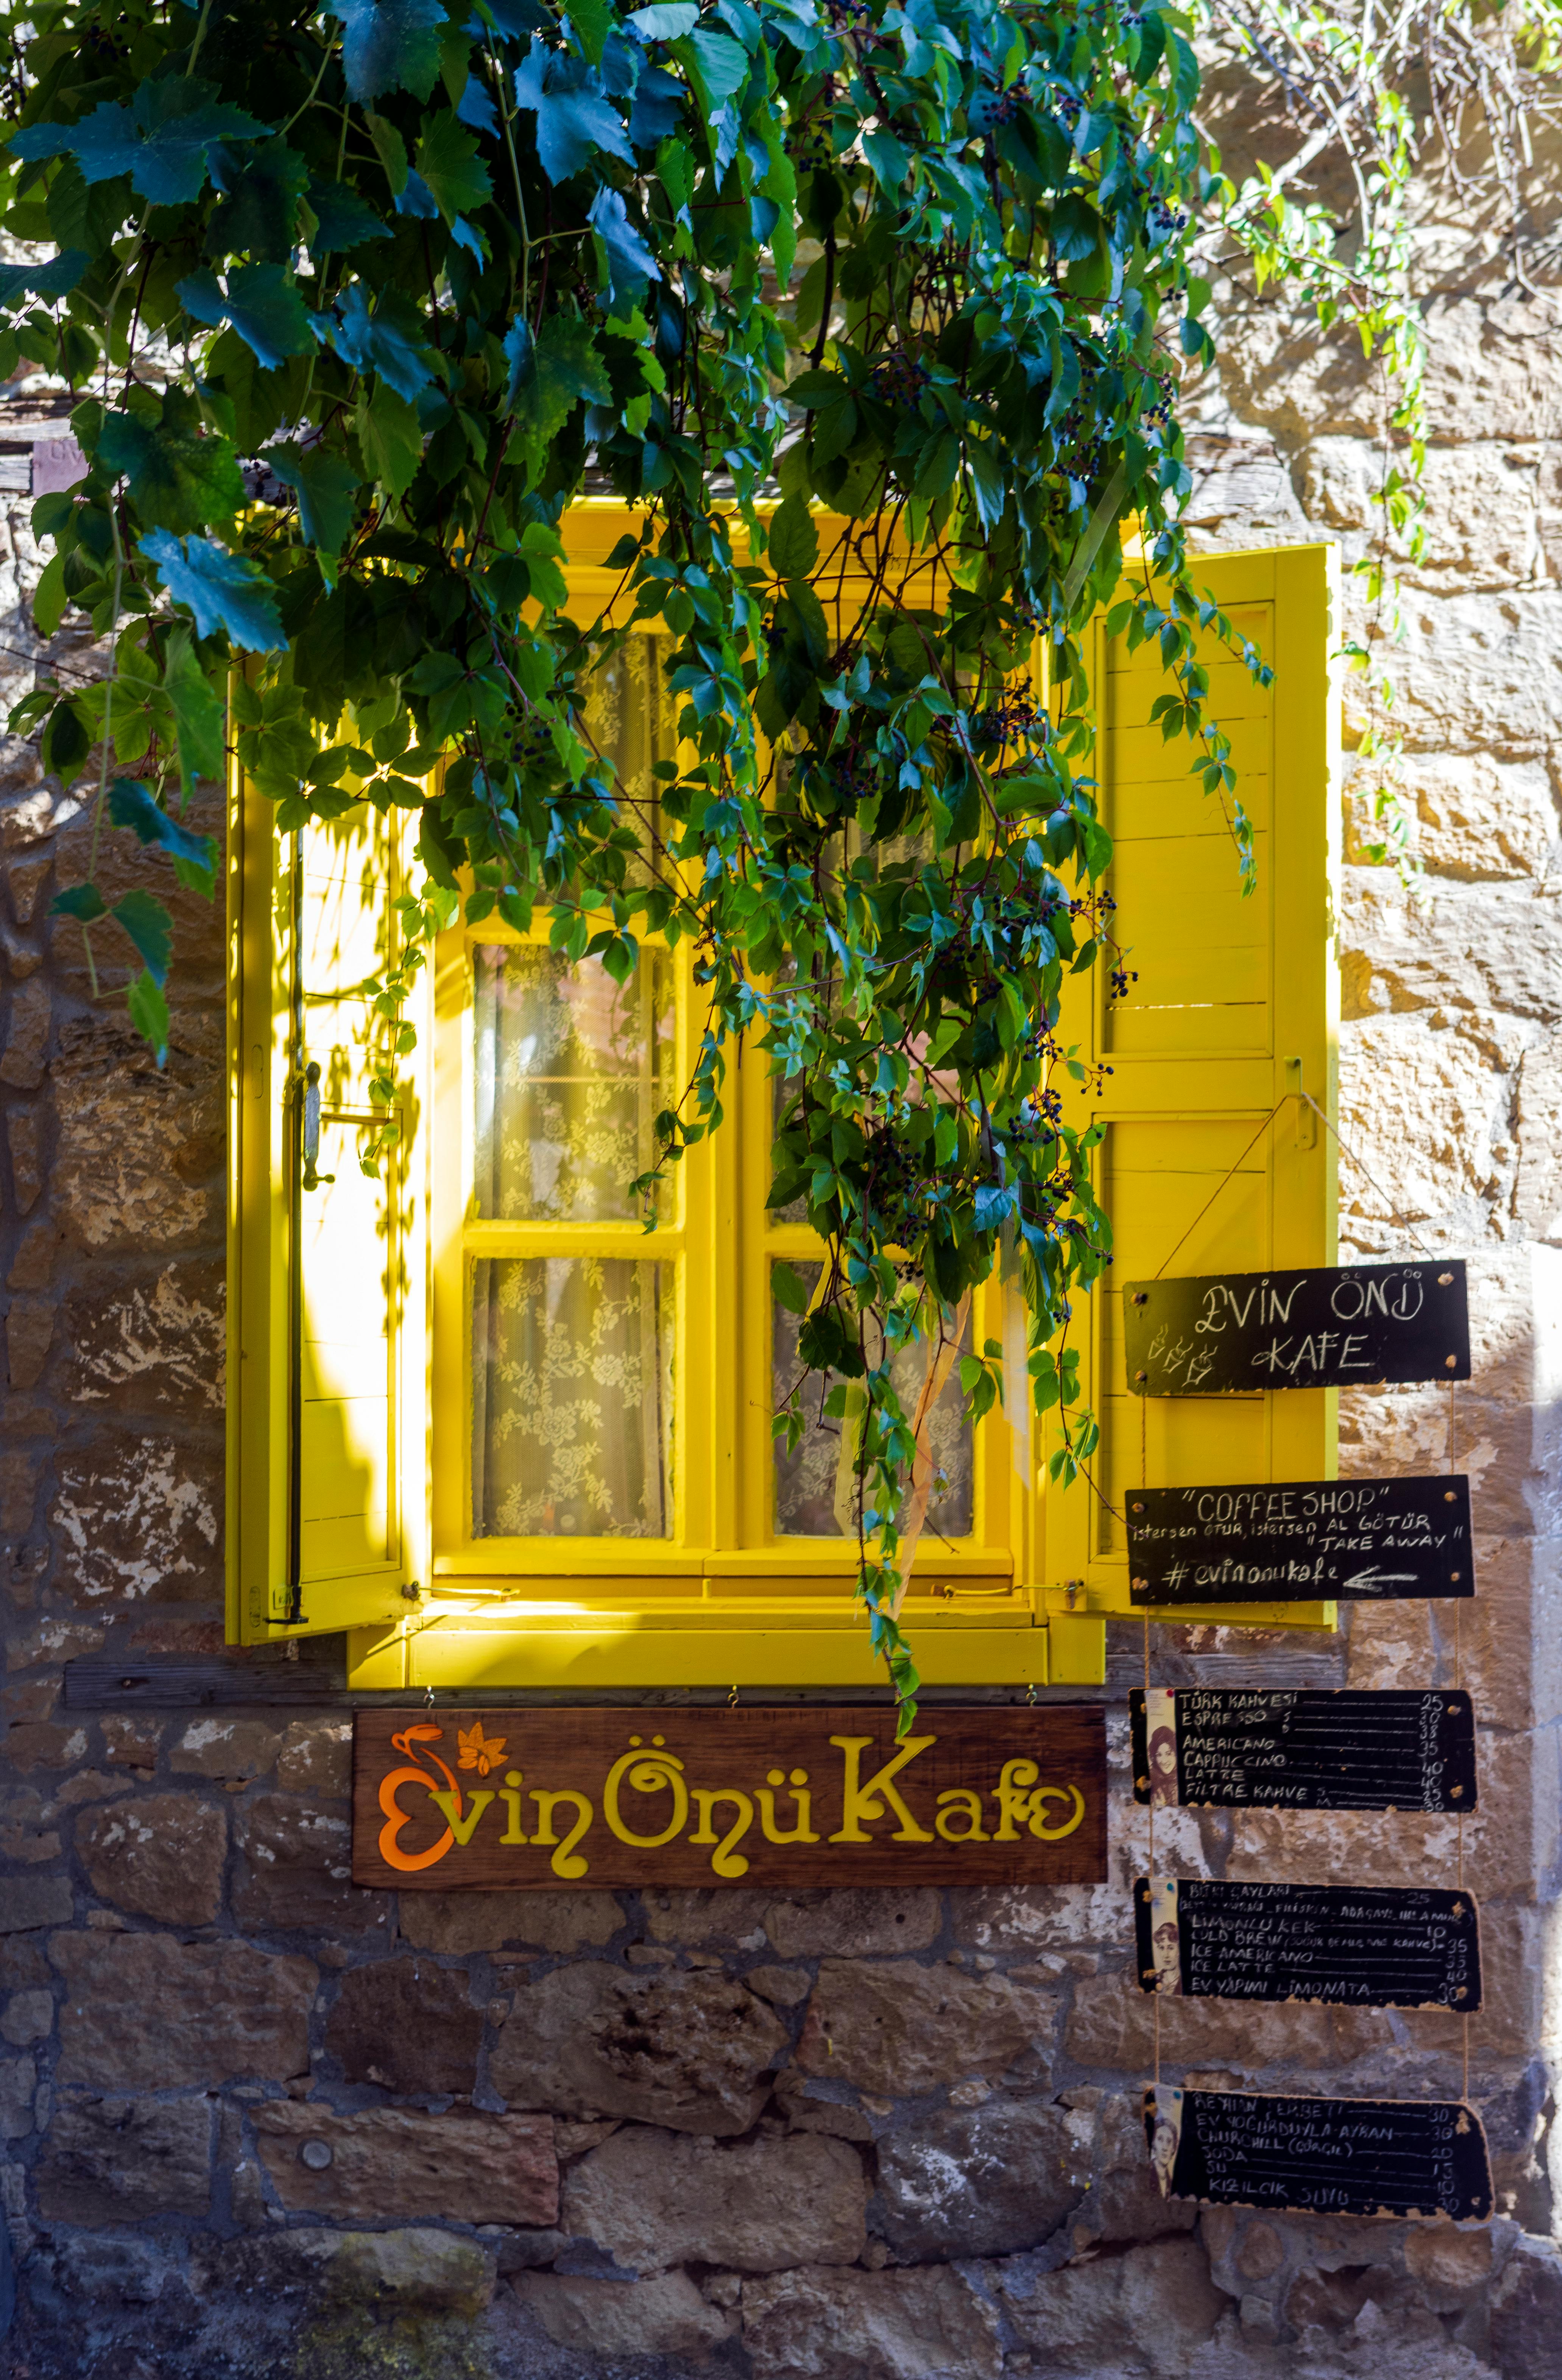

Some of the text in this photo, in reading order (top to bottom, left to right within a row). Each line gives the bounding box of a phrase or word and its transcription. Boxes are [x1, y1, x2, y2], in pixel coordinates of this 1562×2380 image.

[1331, 1268, 1423, 1320] ÖNÜ
[1252, 1331, 1376, 1375] KAFE
[1326, 1518, 1348, 1532] AL
[1358, 1512, 1431, 1532] GÖTÜR
[1420, 1693, 1444, 1712] 25
[1419, 1724, 1439, 1740] 38
[1182, 1734, 1439, 1757] AMERICANO 35
[1183, 1751, 1444, 1777] CAPPUCCINO 40
[1185, 1767, 1442, 1790] LATTE 40
[1253, 1785, 1308, 1801] KAHVE
[1422, 1788, 1442, 1802] 25
[379, 1734, 1086, 1879] Evin Önü Kafe
[1424, 1800, 1445, 1813] 30
[1406, 1892, 1431, 1905] 25
[1277, 1918, 1315, 1934] KEK
[1426, 1925, 1447, 1938] 10
[1235, 1931, 1283, 1946] BREW
[1446, 1938, 1468, 1954] 35
[1191, 1943, 1467, 1969] ICE AMERICANO 35
[1190, 1959, 1467, 1982] ICE LATTE 40
[1191, 1977, 1212, 1991] EV
[1437, 1982, 1461, 2004] 30
[1428, 2107, 1449, 2122] 30
[1196, 2113, 1221, 2127] EV
[1431, 2126, 1453, 2140] 30
[1200, 2145, 1453, 2180] SODA 15
[1430, 2147, 1453, 2159] 20
[1206, 2160, 1455, 2194] SU 10
[1297, 2187, 1349, 2206] SUYU
[1438, 2197, 1460, 2213] 30
